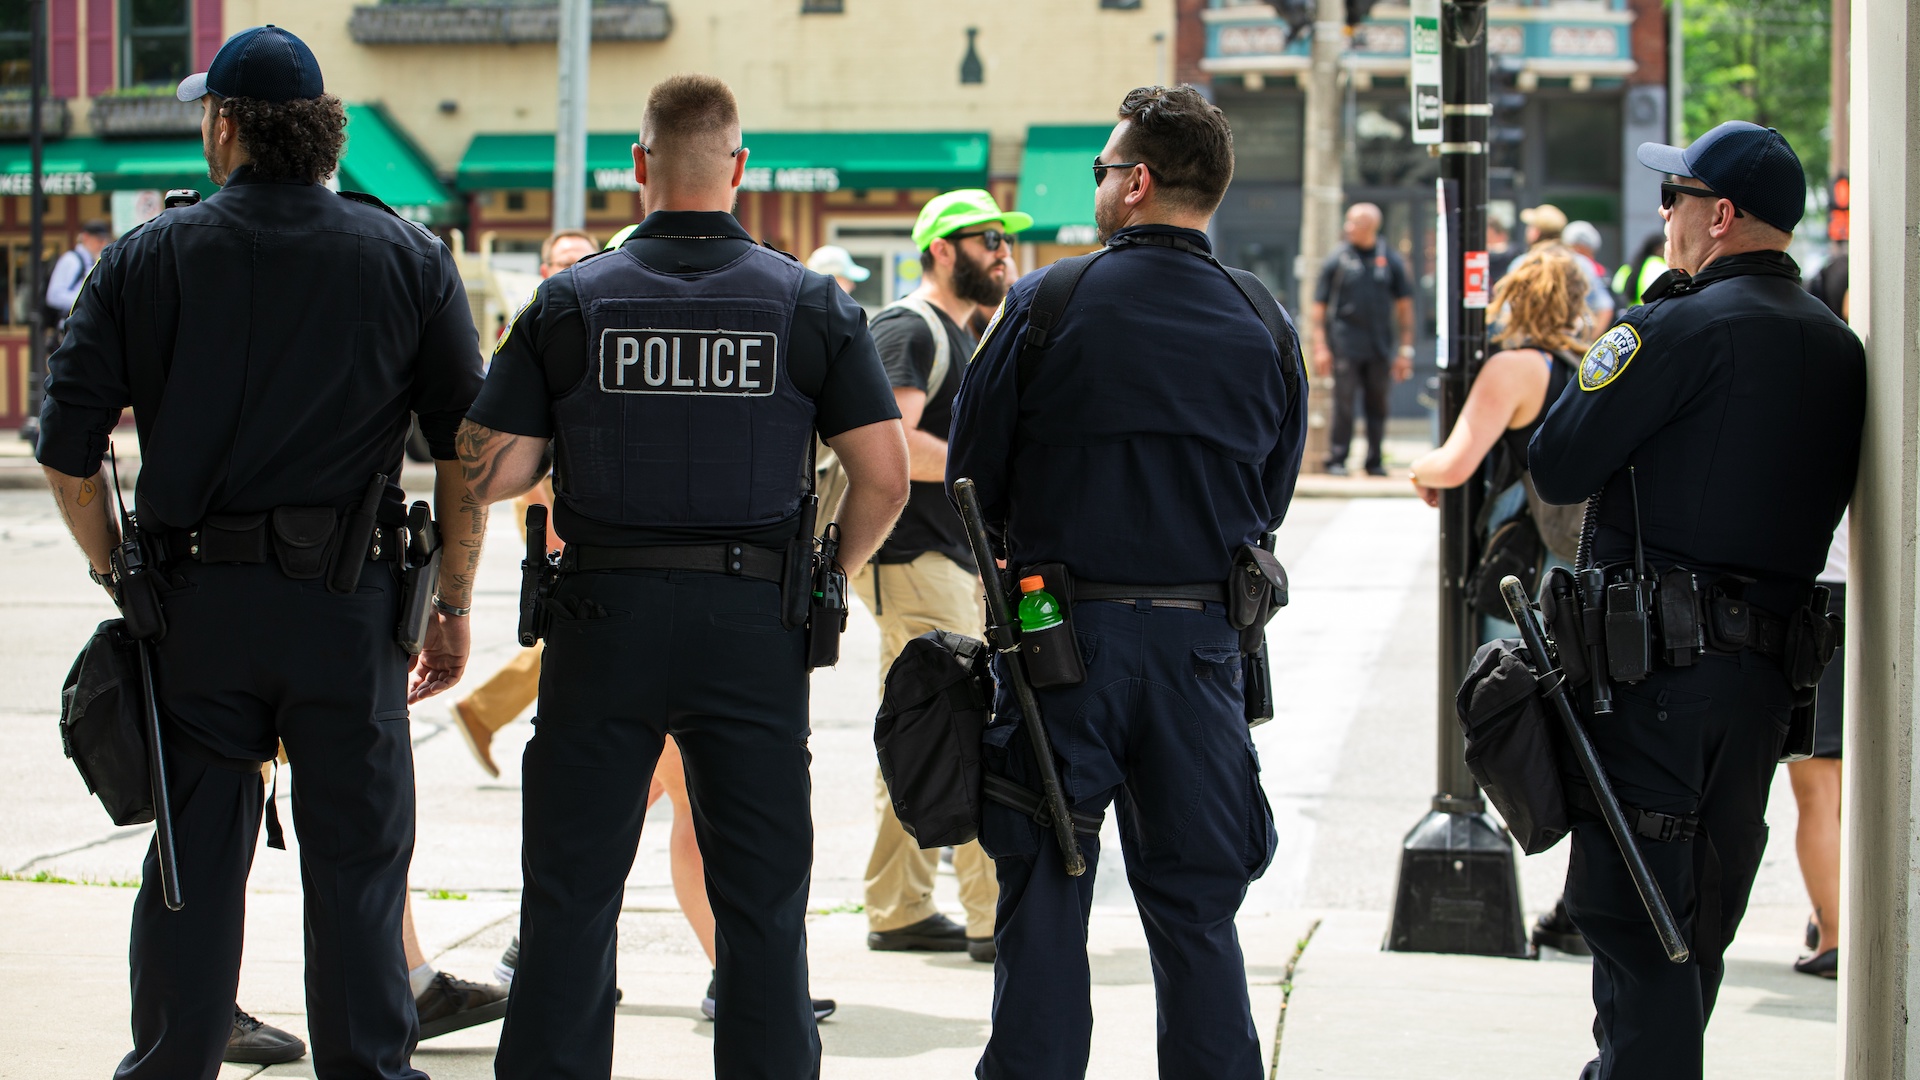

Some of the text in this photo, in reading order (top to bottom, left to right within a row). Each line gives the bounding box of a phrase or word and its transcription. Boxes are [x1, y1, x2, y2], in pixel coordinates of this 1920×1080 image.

[0, 172, 96, 195] KEE MEETS
[594, 168, 640, 191] WHE
[774, 167, 840, 191] MEETS
[616, 336, 762, 388] POLICE
